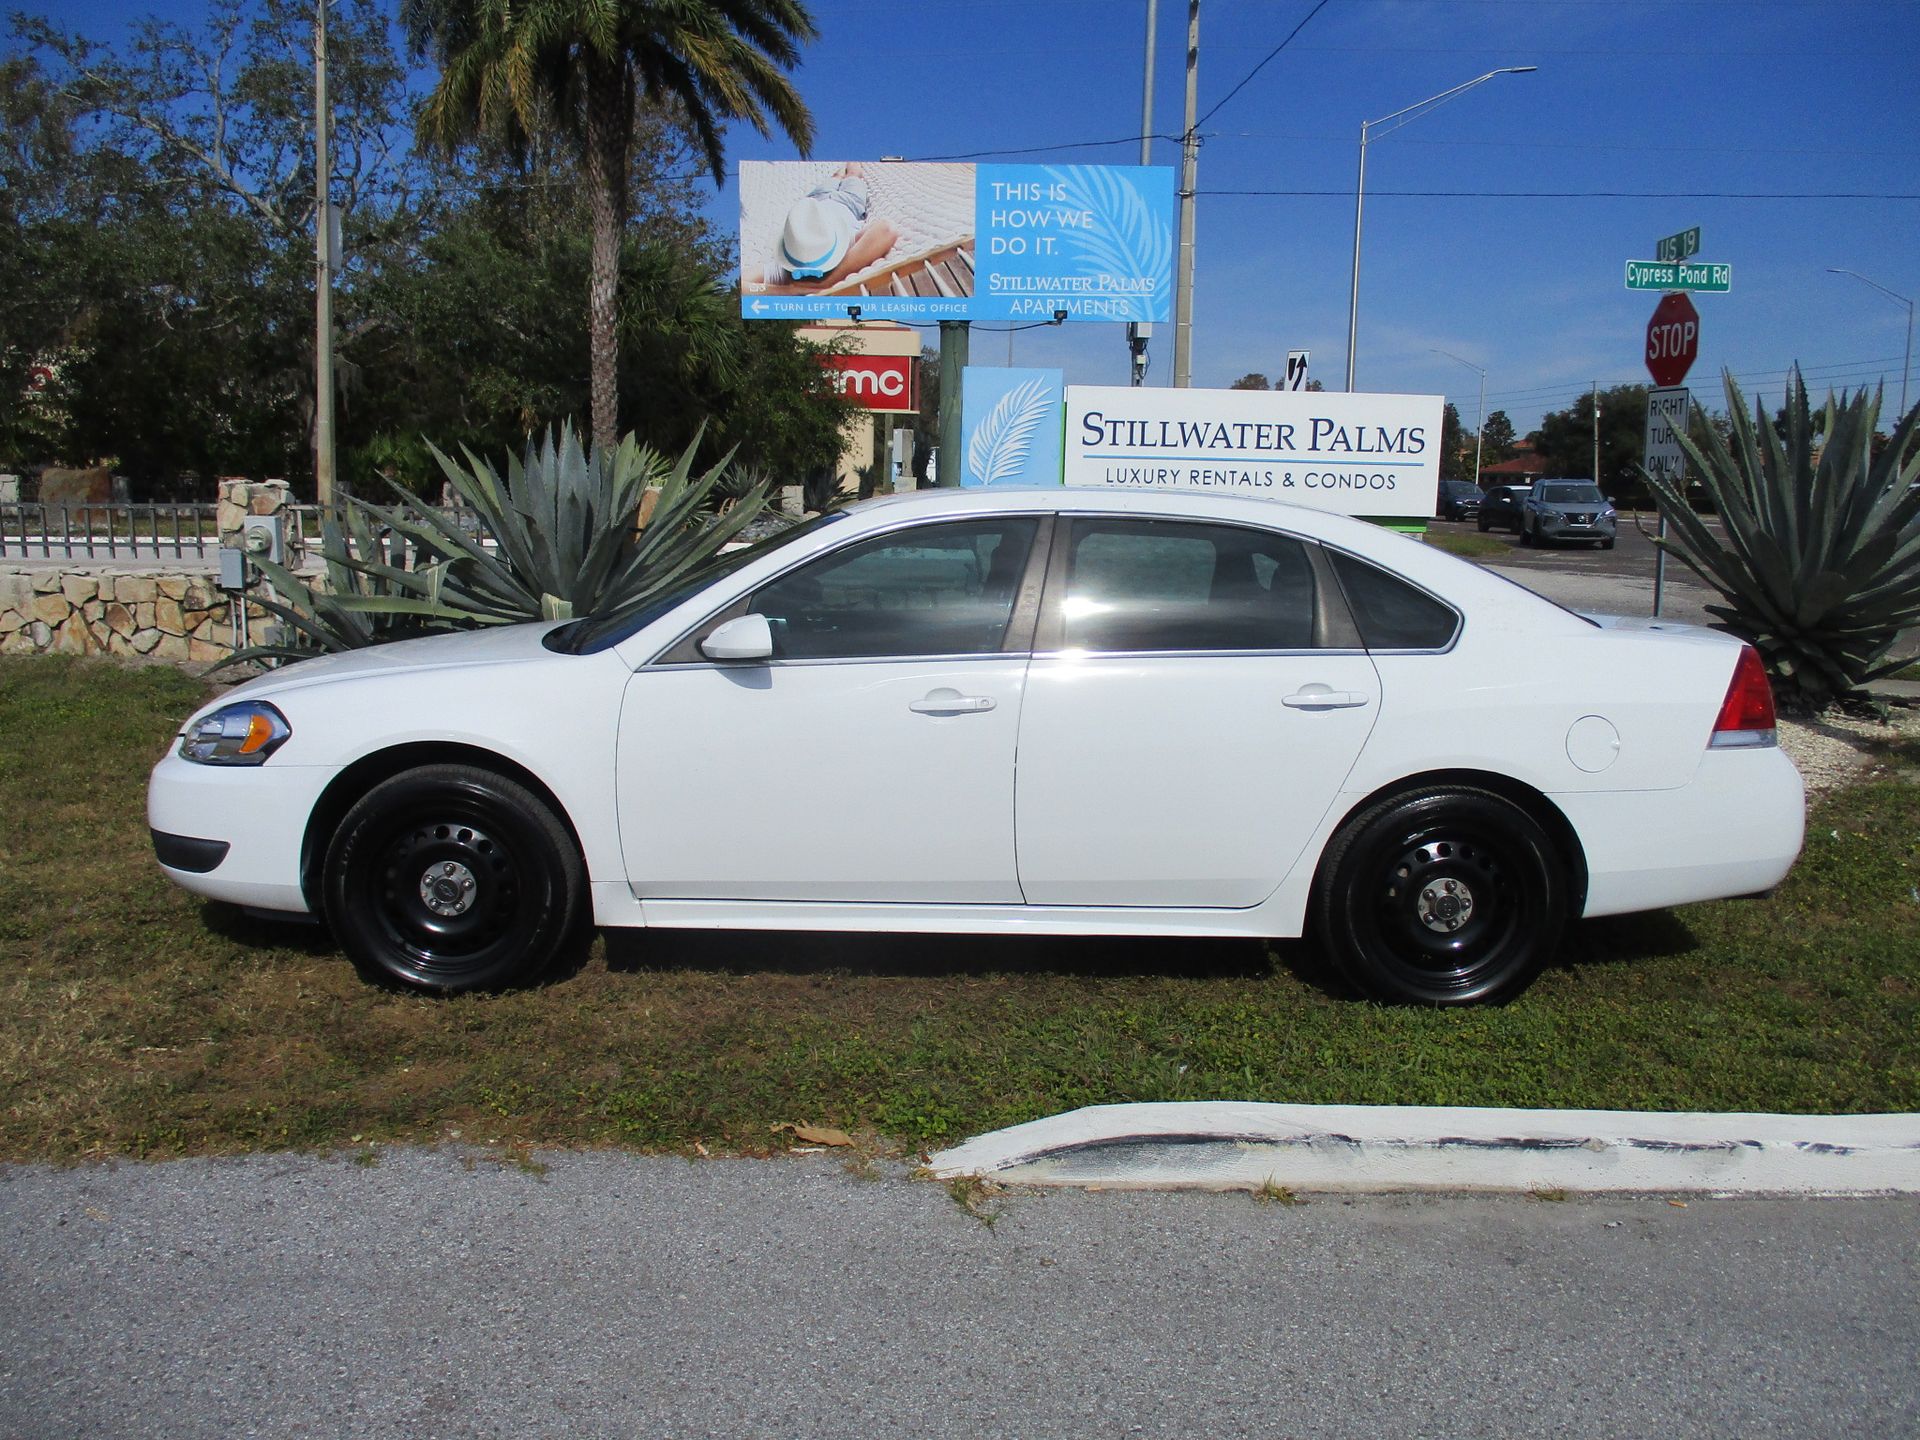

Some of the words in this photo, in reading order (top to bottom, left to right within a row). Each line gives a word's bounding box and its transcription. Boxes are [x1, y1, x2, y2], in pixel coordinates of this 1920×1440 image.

[992, 183, 1040, 201] THIS
[1050, 183, 1066, 201] IS
[991, 210, 1050, 228] HOW
[1056, 210, 1093, 228] WE
[991, 237, 1026, 255] DO
[1036, 237, 1058, 255] IT.
[1660, 237, 1677, 260] US
[1683, 230, 1696, 257] 19
[989, 272, 1093, 291] STILLWATER
[1099, 273, 1155, 292] PALMS
[1627, 263, 1674, 287] Cypress
[1678, 265, 1708, 284] Pond
[1713, 266, 1728, 285] Rd
[774, 303, 804, 312] TURN
[808, 303, 831, 312] LEFT
[835, 303, 849, 312] TO
[881, 303, 926, 312] LEASING
[930, 304, 968, 313] OFFICE
[1010, 299, 1129, 316] APARTMENTS
[1649, 321, 1696, 360] STOP
[1650, 398, 1684, 416] RIGHT
[1081, 411, 1296, 450] STILLWATER
[1307, 417, 1426, 454] PALMS
[1651, 428, 1678, 444] TUR
[1648, 456, 1679, 472] ONLY
[1106, 467, 1181, 485] LUXURY
[1190, 469, 1273, 487] RENTALS
[1282, 472, 1295, 487] &
[1304, 472, 1396, 490] CONDOS
